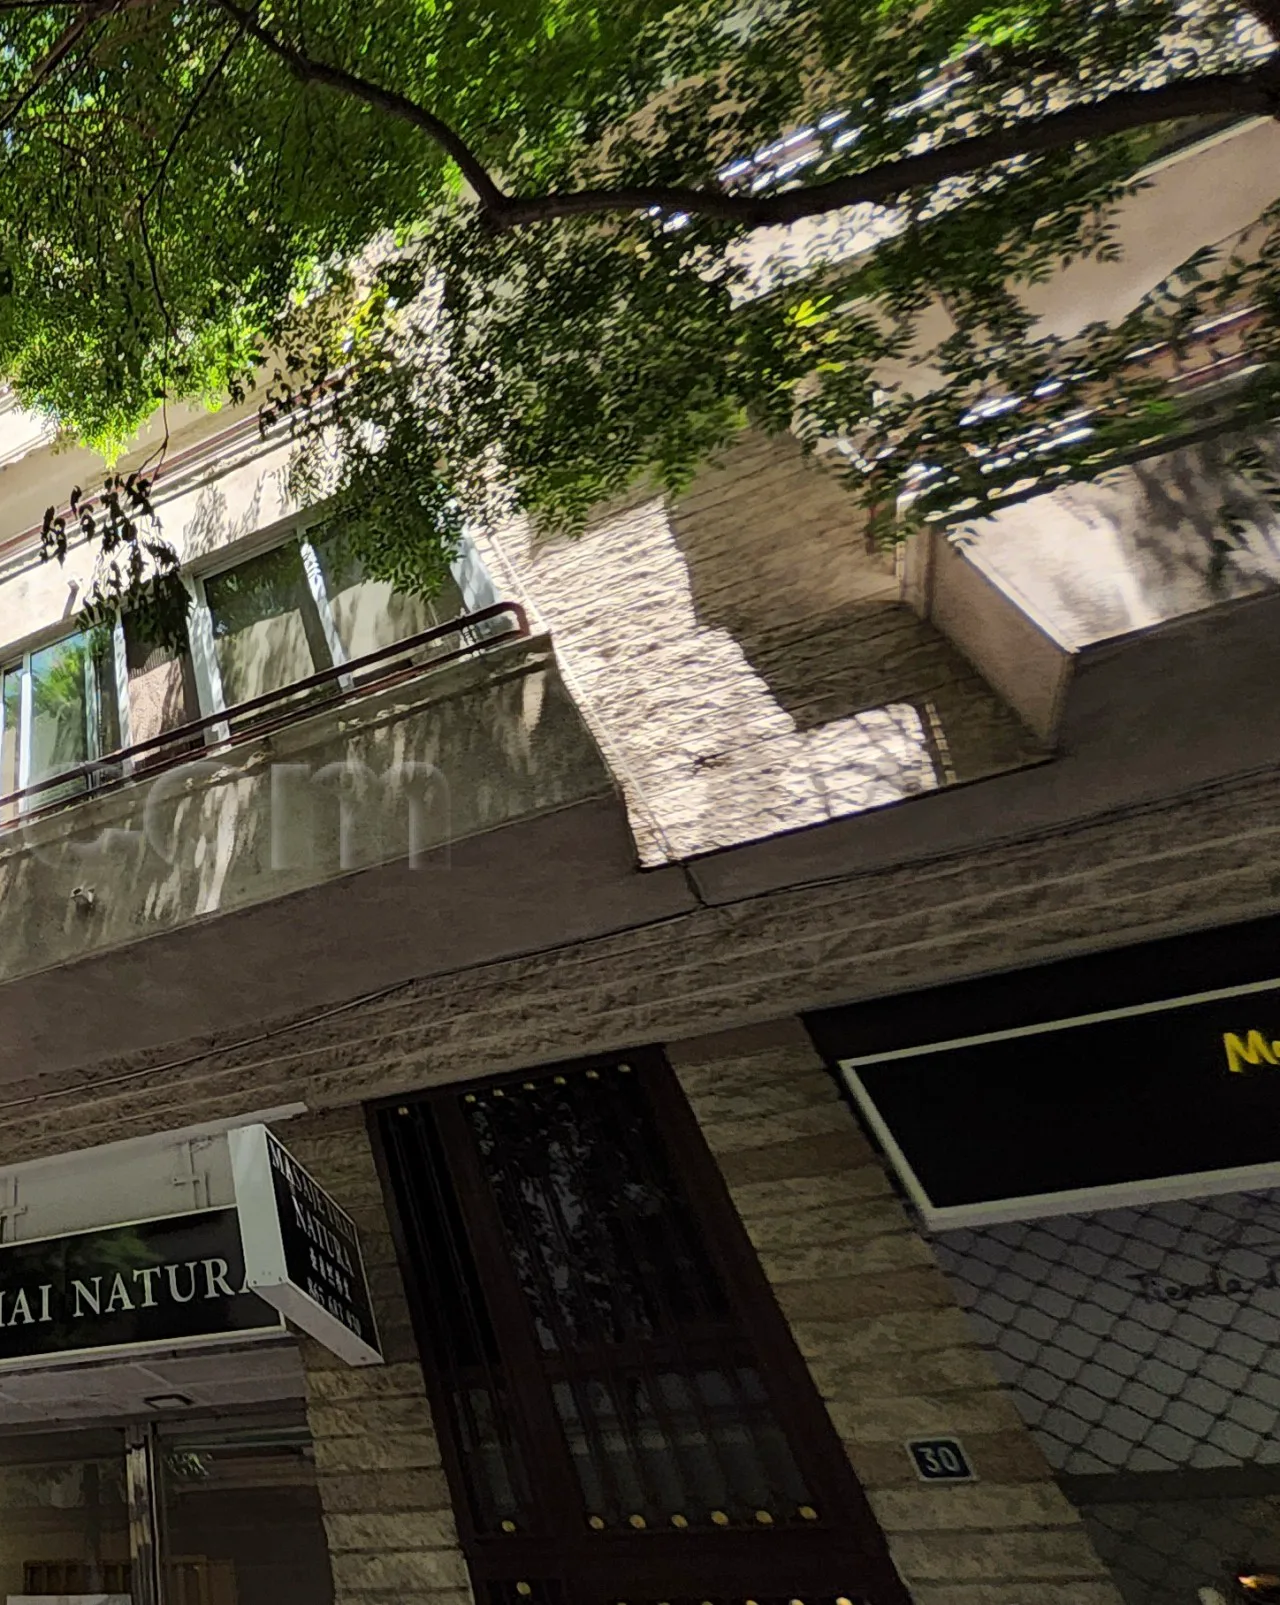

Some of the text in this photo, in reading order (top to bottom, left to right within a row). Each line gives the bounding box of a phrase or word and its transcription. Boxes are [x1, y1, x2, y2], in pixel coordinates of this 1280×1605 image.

[1223, 1029, 1280, 1073] M
[269, 1138, 325, 1216] MASAJE
[292, 1195, 355, 1278] NATURA
[920, 1447, 960, 1473] 30
